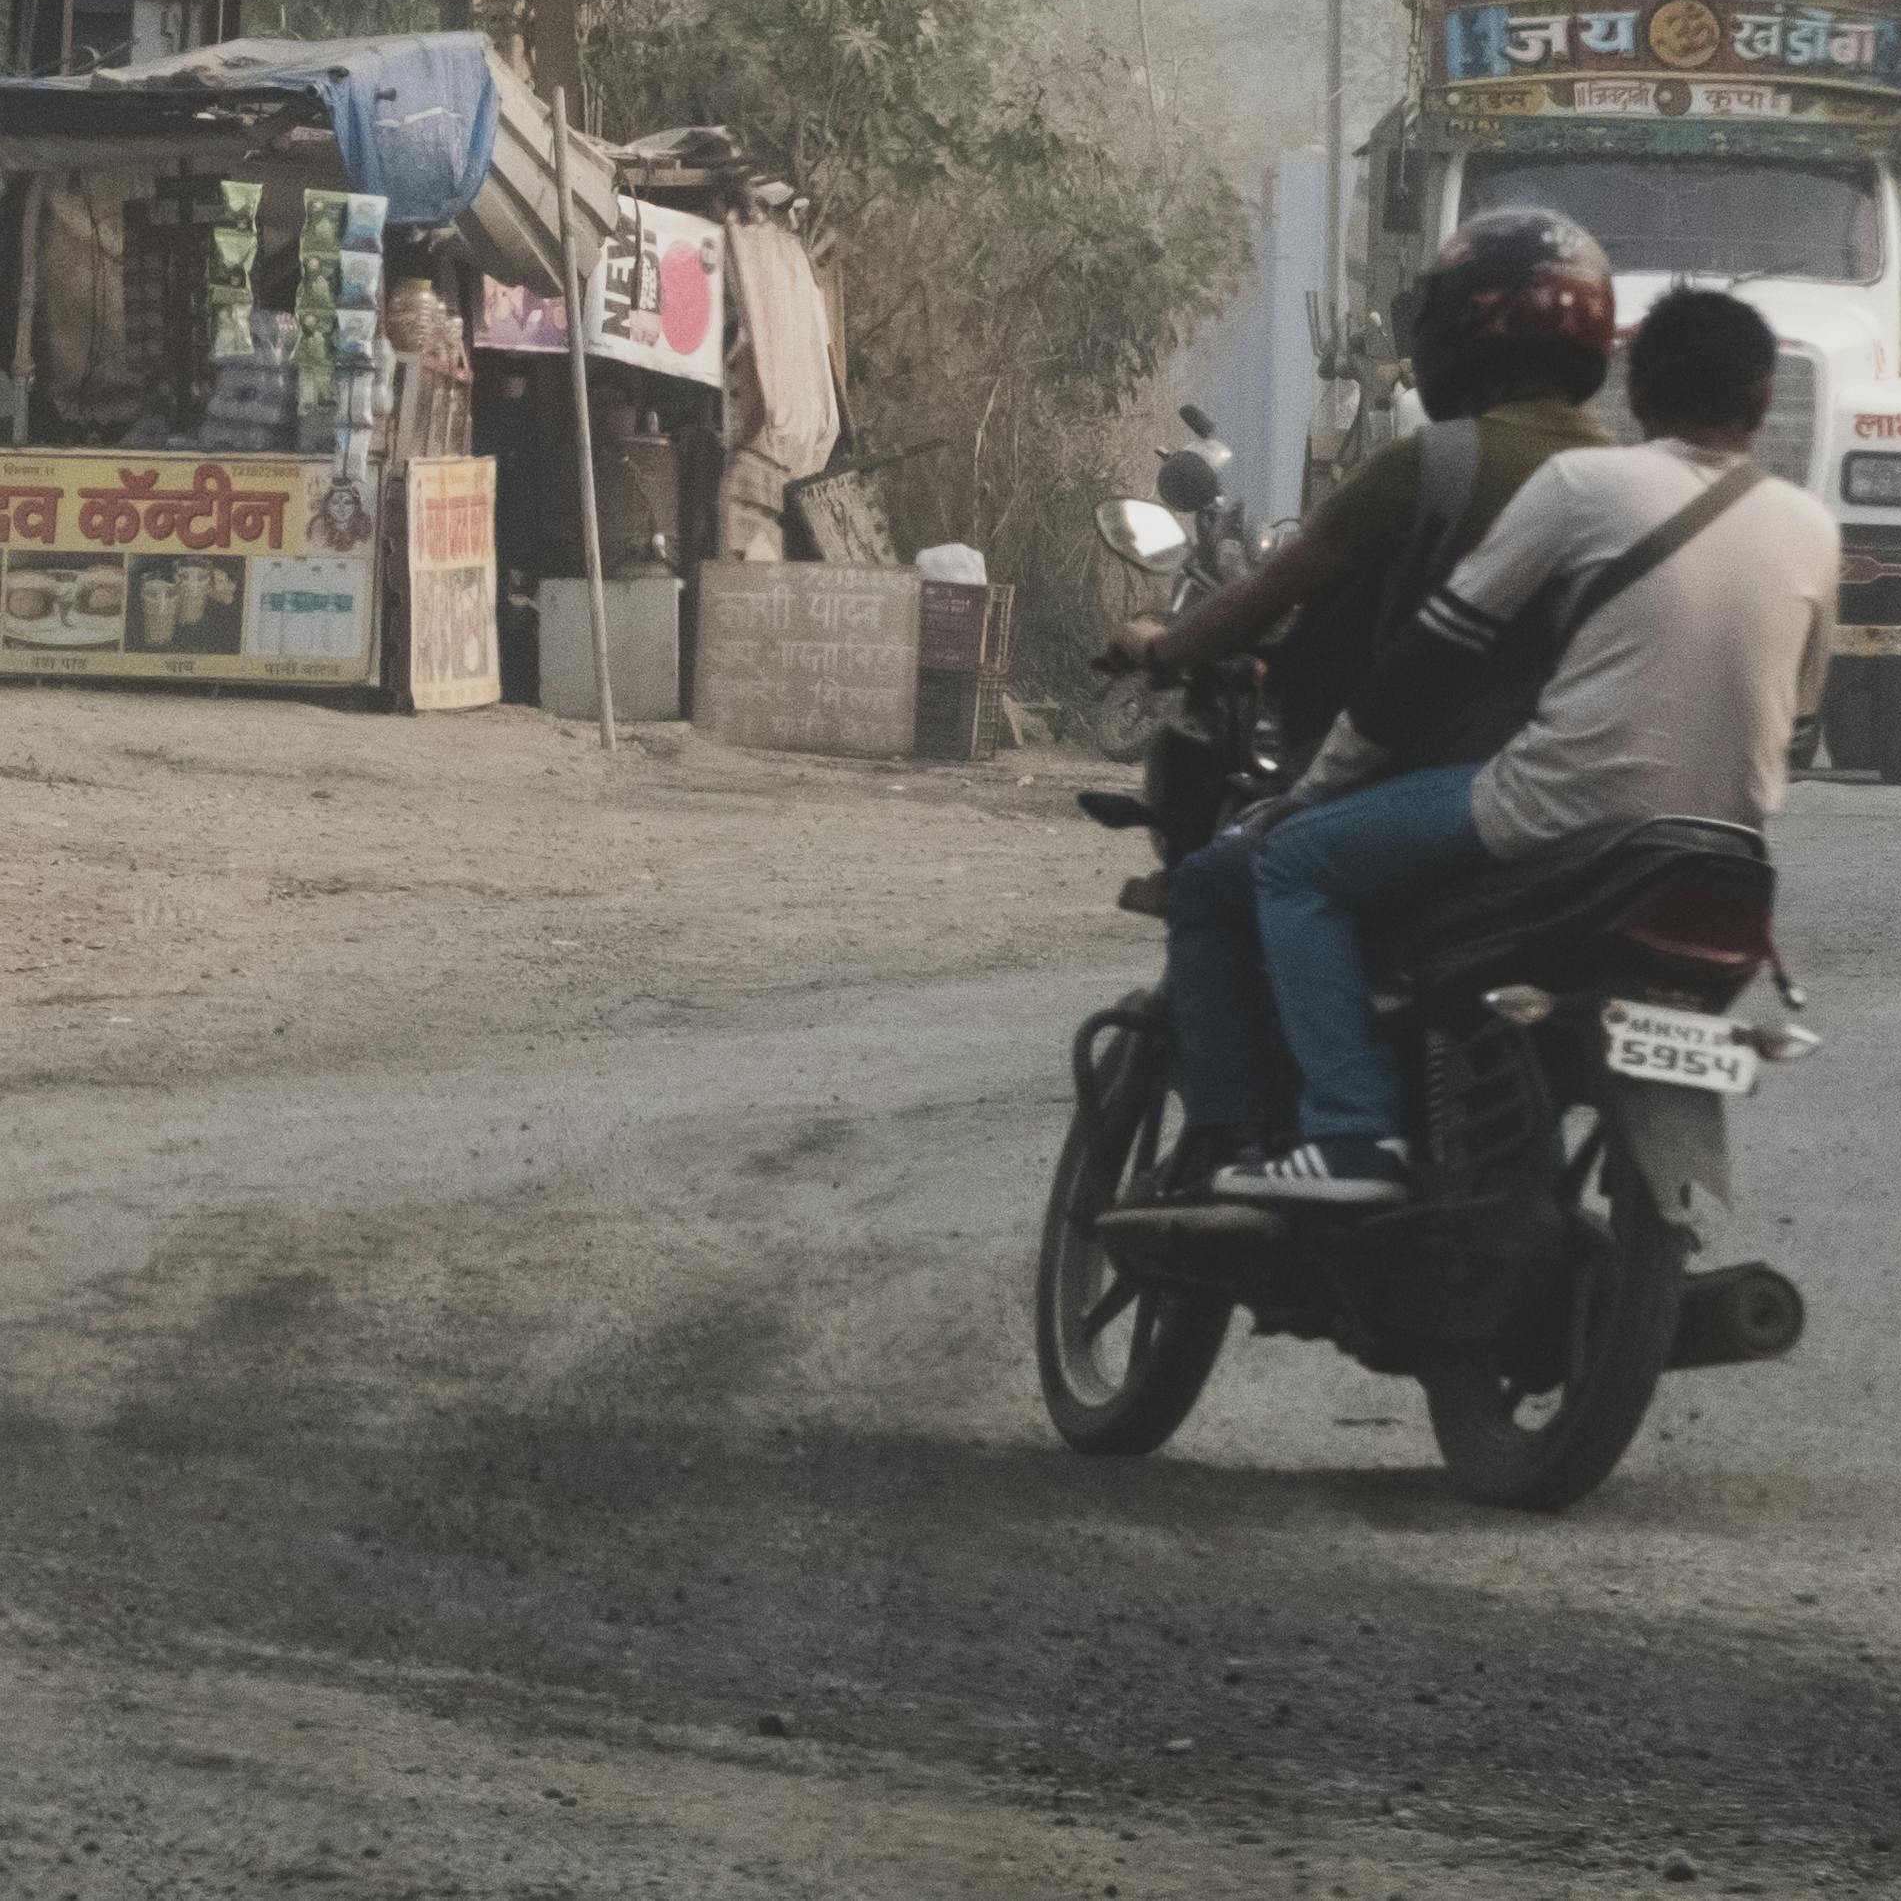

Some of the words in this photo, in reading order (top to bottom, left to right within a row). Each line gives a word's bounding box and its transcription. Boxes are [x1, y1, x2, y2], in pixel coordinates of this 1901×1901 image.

[1506, 11, 1640, 63] जय
[1734, 2, 1878, 66] खंडोबा
[78, 464, 290, 550] कॅन्टीन
[1621, 1038, 1740, 1083] 5954
